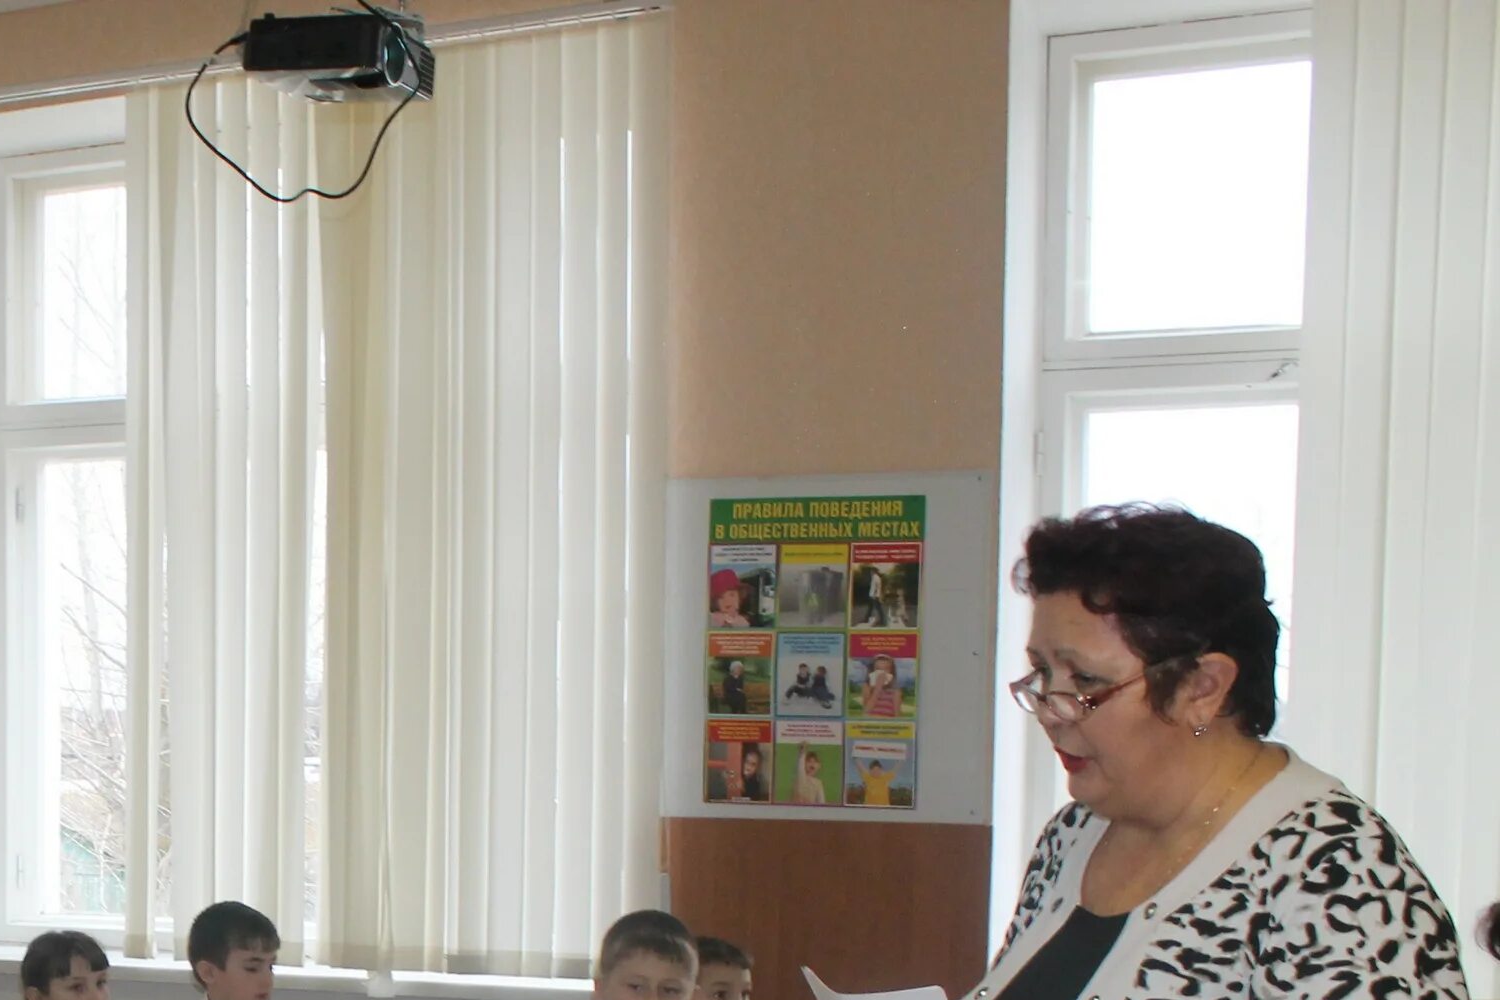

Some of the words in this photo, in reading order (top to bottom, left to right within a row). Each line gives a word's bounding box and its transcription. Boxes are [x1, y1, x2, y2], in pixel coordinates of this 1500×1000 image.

[731, 501, 804, 519] ПРАВИЛА
[809, 500, 903, 519] ПОВЕДЕНИЯ
[714, 525, 724, 539] В
[729, 522, 852, 540] ОБЩЕСТВЕННЫХ
[858, 521, 920, 537] МЕСТАХ
